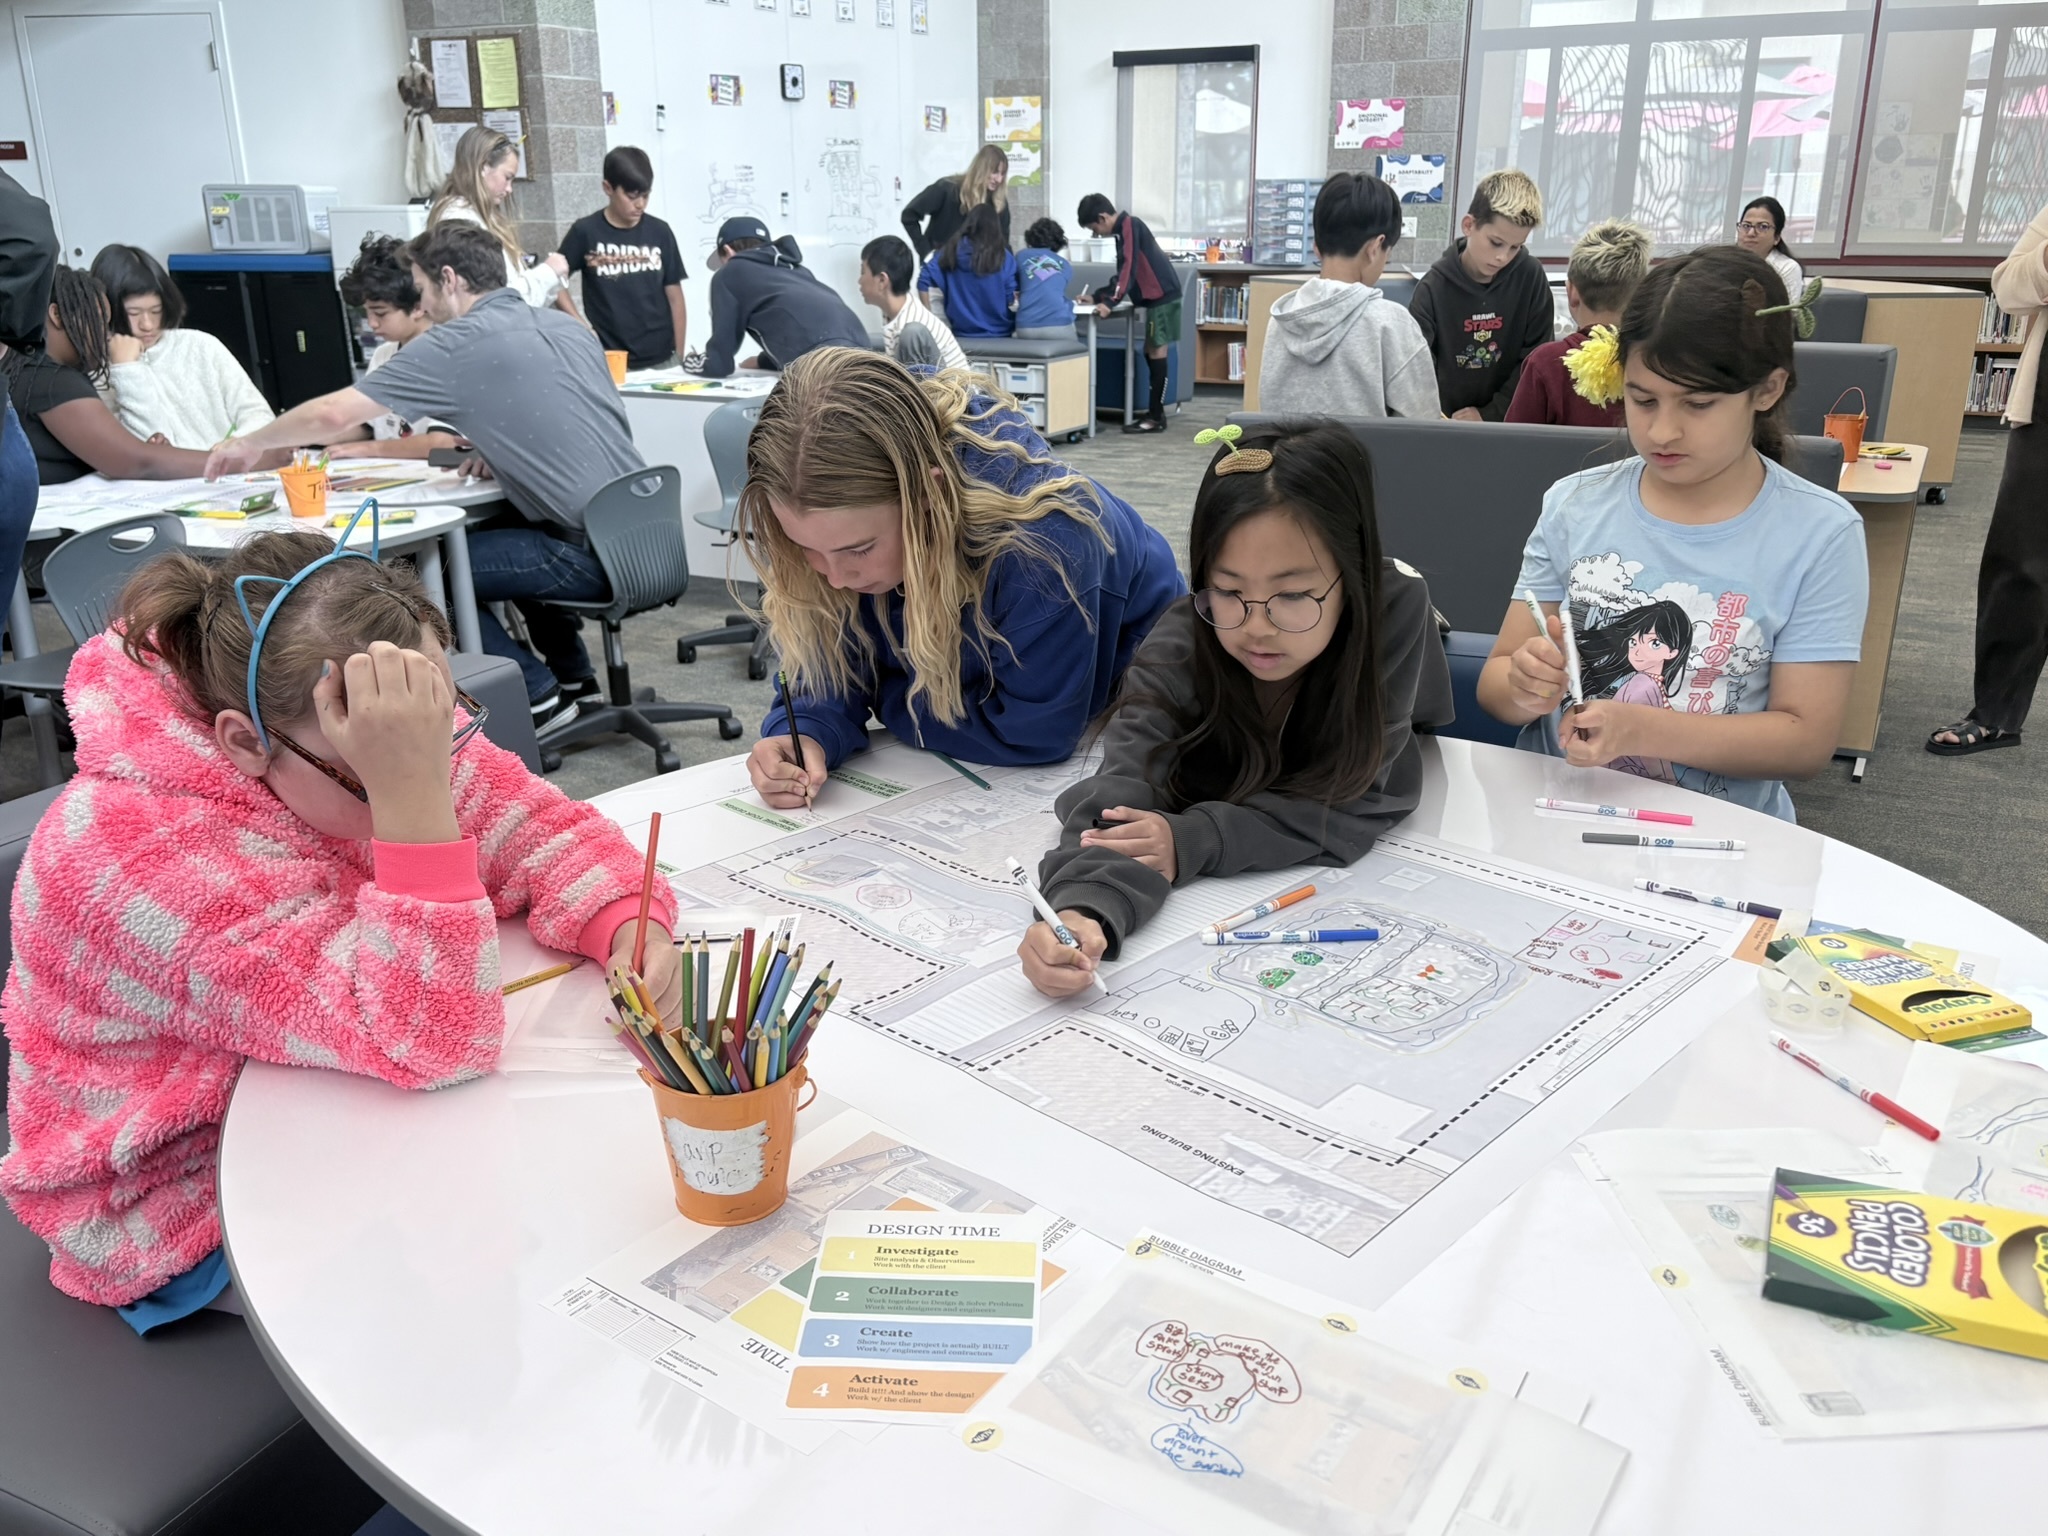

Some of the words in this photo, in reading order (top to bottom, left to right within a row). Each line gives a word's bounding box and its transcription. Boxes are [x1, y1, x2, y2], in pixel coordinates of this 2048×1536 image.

[596, 242, 663, 276] ADIDAS
[1464, 317, 1503, 332] STARS
[1687, 591, 1749, 714] 都市の喜び
[724, 803, 746, 816] DESIGN
[746, 812, 762, 821] YOUR
[762, 817, 795, 832] DESCRIBE
[1831, 954, 1906, 971] MARKERS
[1914, 995, 1992, 1014] Crayola
[1140, 1124, 1193, 1152] BUILDING
[1192, 1149, 1245, 1176] EXISTING
[867, 1224, 944, 1236] DESIGN
[948, 1226, 1001, 1237] TIME
[1797, 1213, 1825, 1235] 36
[1844, 1198, 1888, 1275] PENCILS
[1887, 1200, 1929, 1286] COLORED
[848, 1251, 856, 1260] 1
[876, 1246, 959, 1256] Investigate
[1148, 1234, 1189, 1256] BUBBLE
[1190, 1251, 1242, 1276] DIAGRAM
[889, 1256, 918, 1264] analysis
[834, 1290, 850, 1302] 2
[868, 1286, 960, 1297] Collaborate
[888, 1298, 920, 1306] together
[930, 1300, 957, 1308] Design
[860, 1326, 913, 1338] Create
[824, 1334, 840, 1348] 3
[857, 1338, 878, 1346] Show
[912, 1341, 940, 1349] project
[950, 1342, 980, 1350] actually
[740, 1338, 790, 1369] TIME
[892, 1347, 930, 1356] engineers
[931, 1348, 947, 1356] and
[1710, 1349, 1746, 1390] DIAGRAM
[850, 1374, 919, 1387] Activate
[812, 1382, 830, 1397] 4
[848, 1386, 870, 1394] Build
[888, 1388, 906, 1396] And
[944, 1391, 975, 1400] design!
[847, 1394, 869, 1402] Work
[899, 1396, 922, 1404] client
[1738, 1392, 1772, 1426] BUBBLE
[1161, 1446, 1185, 1463] the
